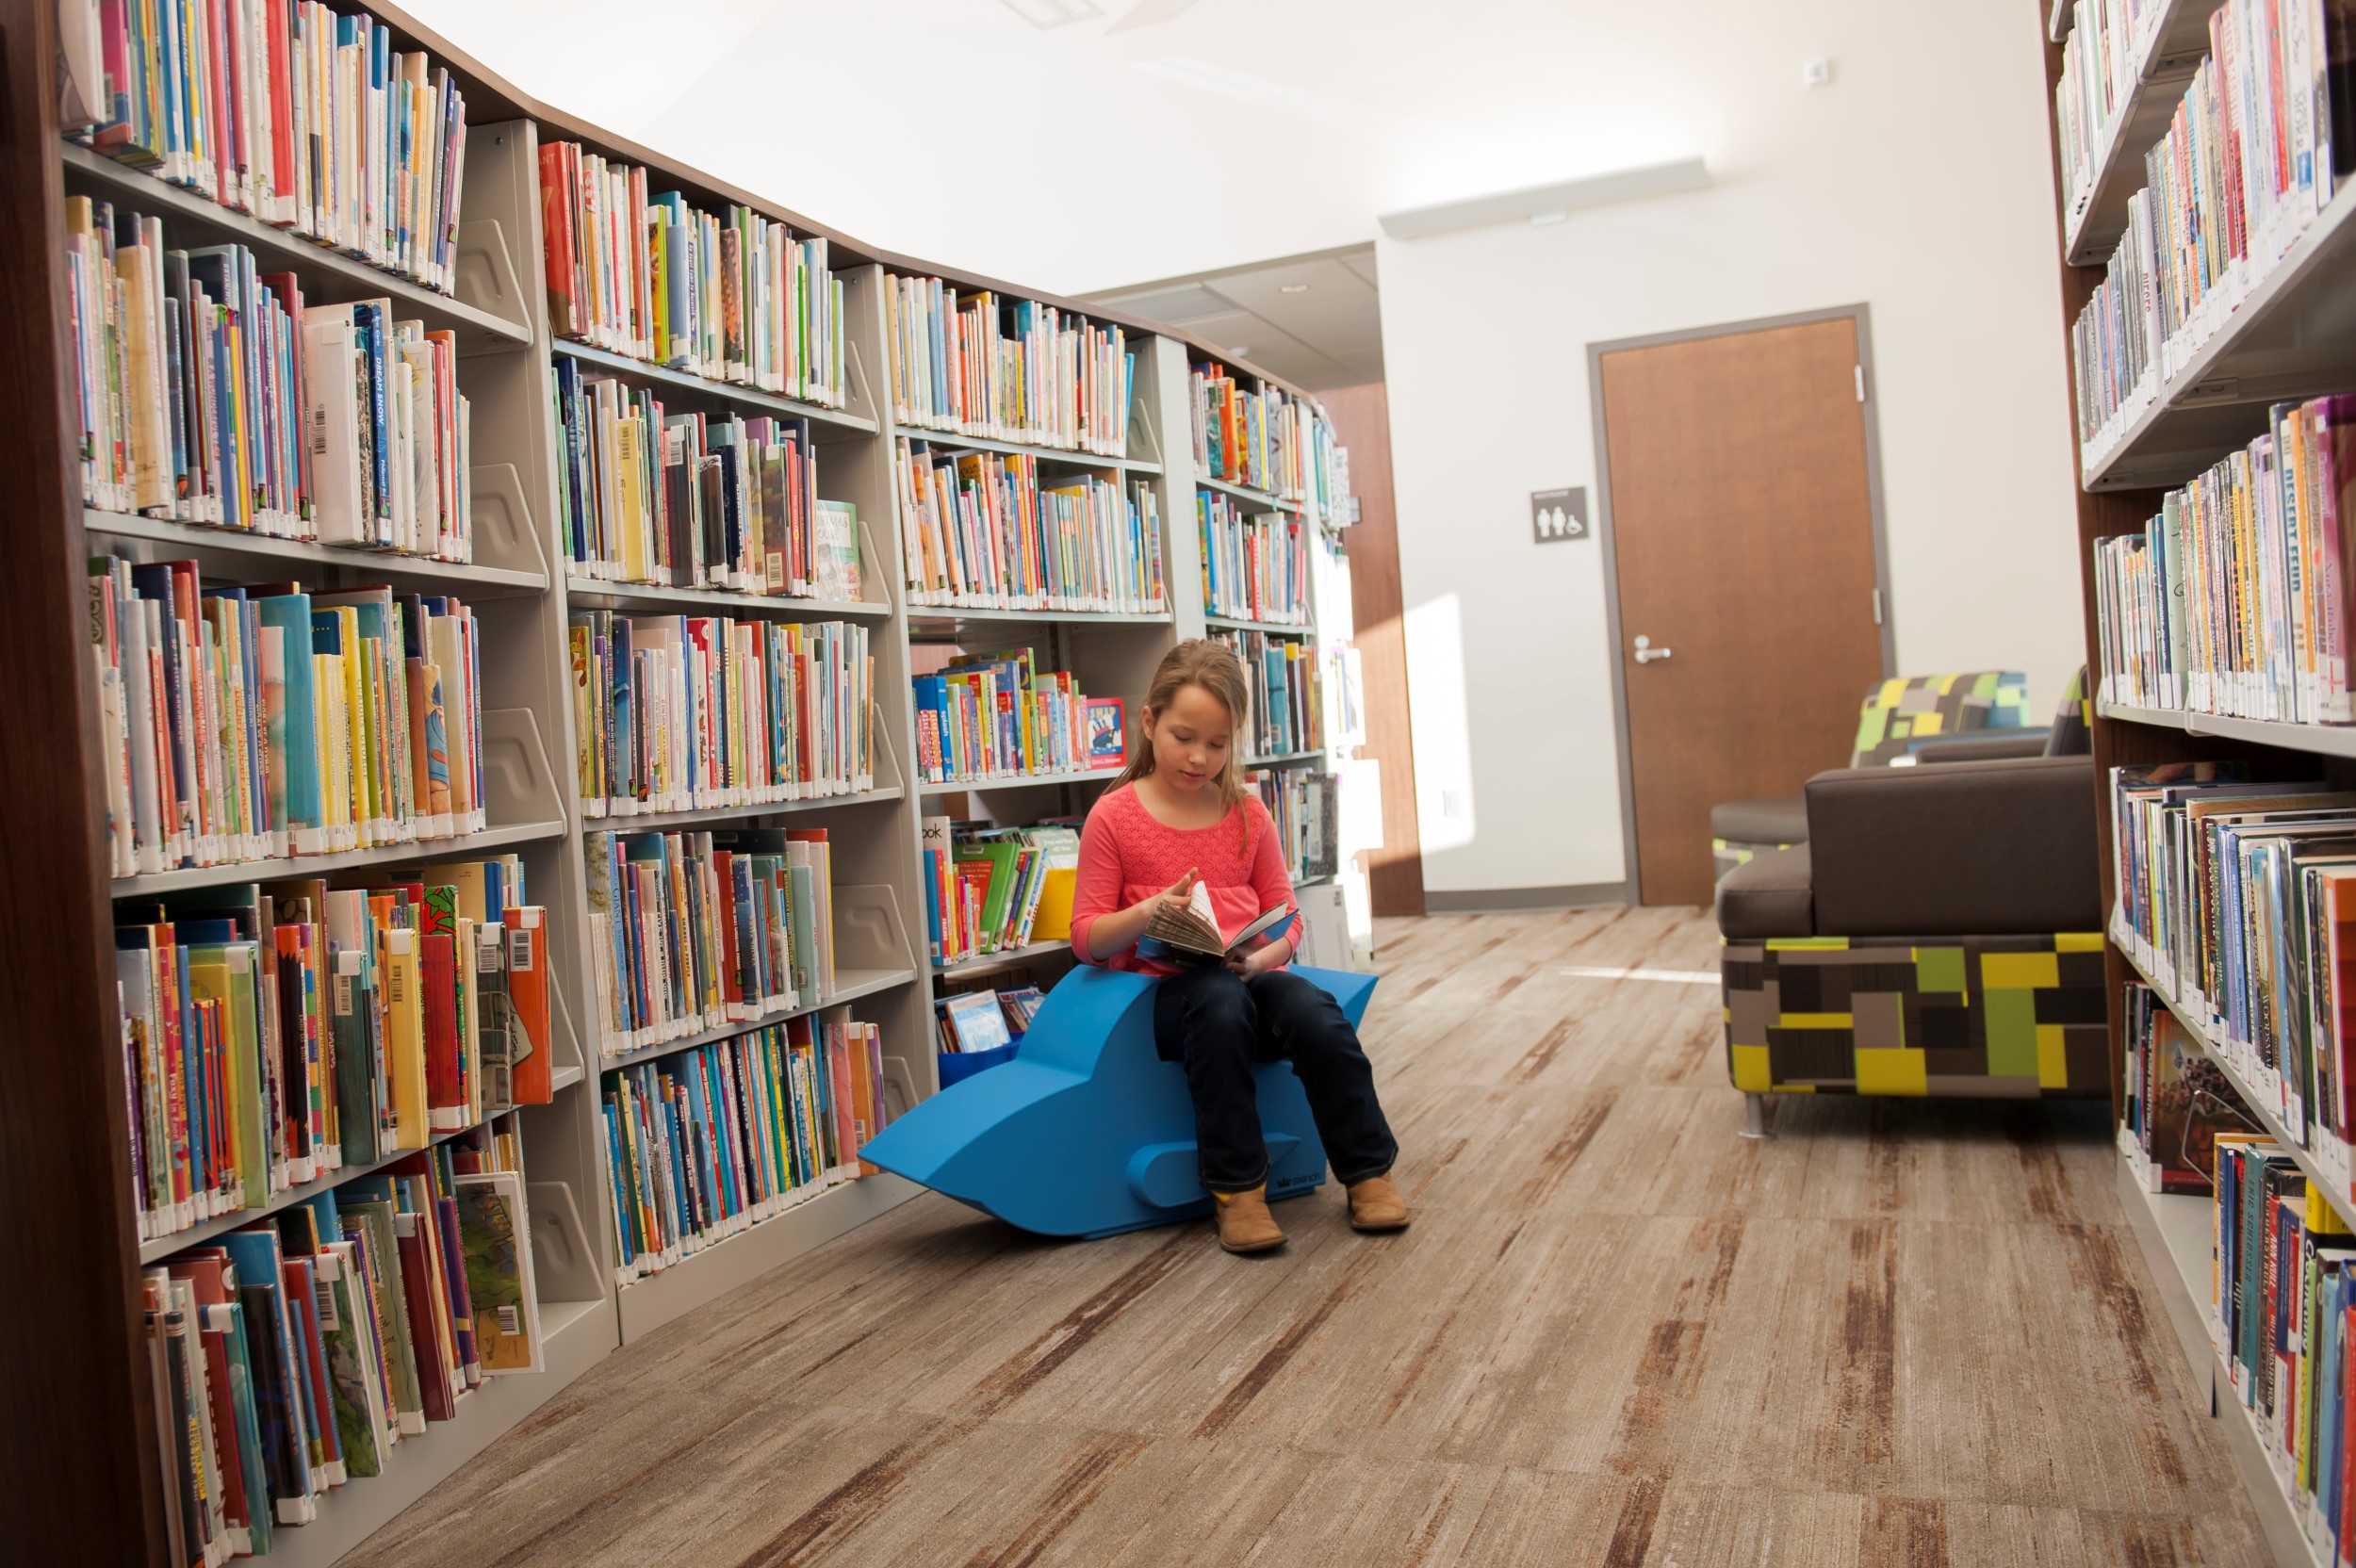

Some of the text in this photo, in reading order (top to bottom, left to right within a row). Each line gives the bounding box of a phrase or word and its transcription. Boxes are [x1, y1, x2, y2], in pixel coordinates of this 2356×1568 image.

[2285, 468, 2300, 593] DESERT FEUD
[2229, 560, 2242, 633] SIXKILL
[941, 710, 950, 737] splash
[1090, 706, 1116, 719] SHIP
[613, 888, 621, 925] GIANT
[2320, 915, 2329, 943] NO
[170, 1072, 180, 1139] Foxy in Love
[1292, 1172, 1320, 1184] sixinch
[2245, 1212, 2254, 1283] SCHLOSSER
[2263, 1182, 2274, 1298] THUNDERSTRUCK
[2269, 1233, 2279, 1289] ANN RULE
